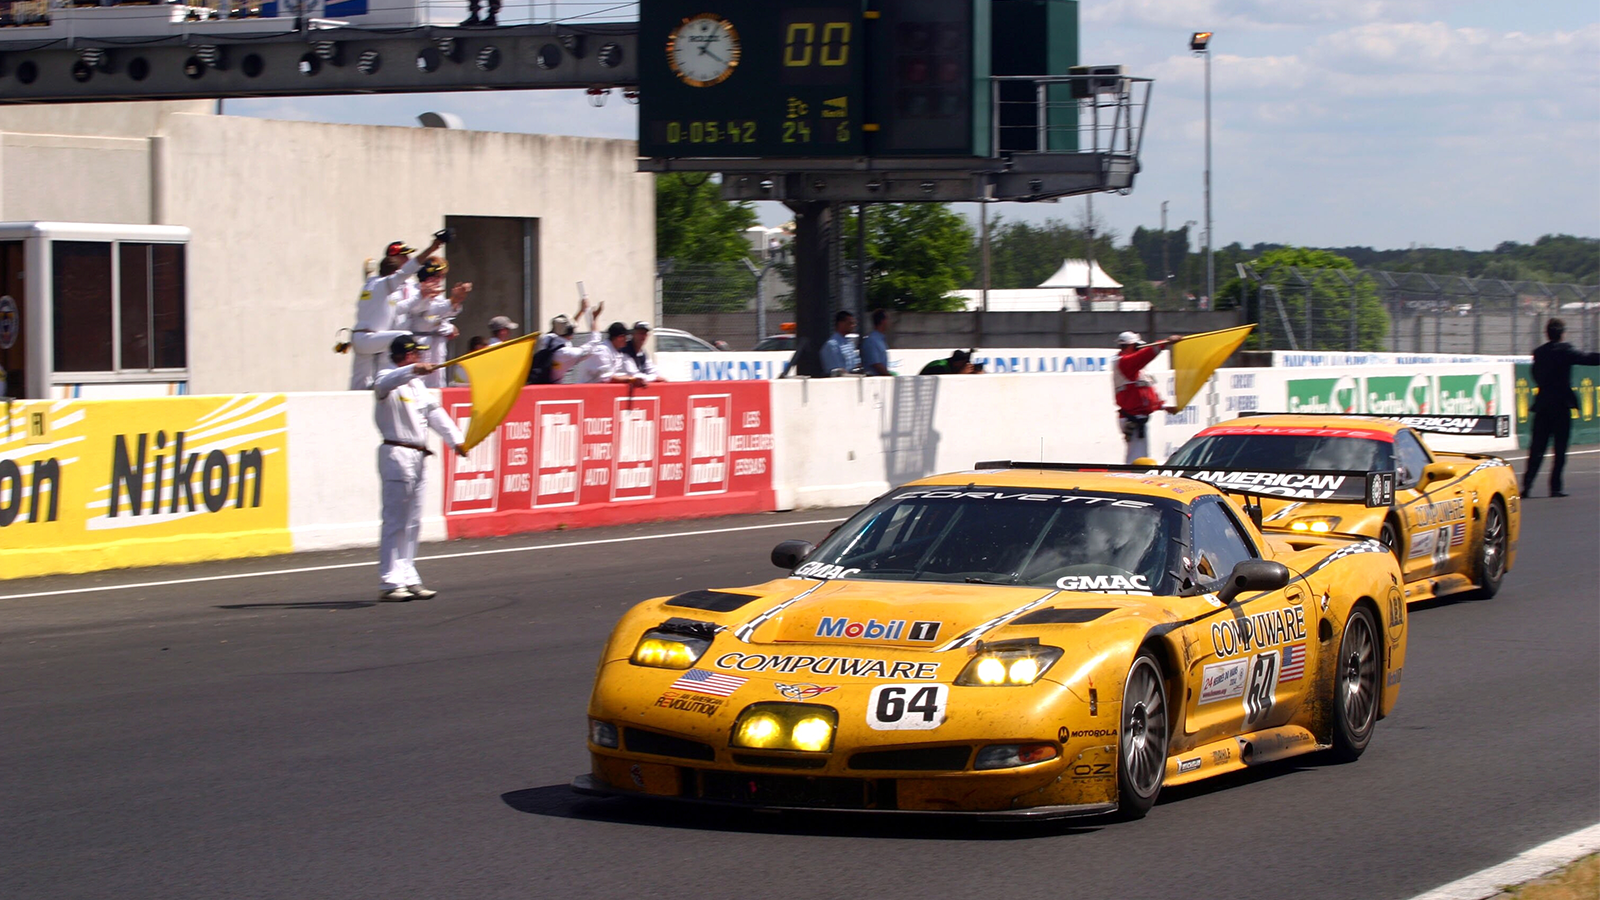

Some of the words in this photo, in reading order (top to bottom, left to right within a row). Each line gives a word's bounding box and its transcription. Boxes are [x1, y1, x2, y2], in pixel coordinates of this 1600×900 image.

[108, 430, 262, 519] Nikon
[1191, 471, 1345, 490] AMERICAN
[892, 490, 1154, 509] CORVETTE
[1056, 574, 1151, 591] GMAC
[816, 617, 904, 640] Mobil
[1212, 605, 1307, 659] COMPUWARE
[716, 652, 939, 680] COMPUWARE
[1248, 654, 1276, 724] 64
[654, 696, 720, 717] REVOLUTION
[876, 686, 938, 723] 64
[1071, 729, 1118, 738] MOTOROLA
